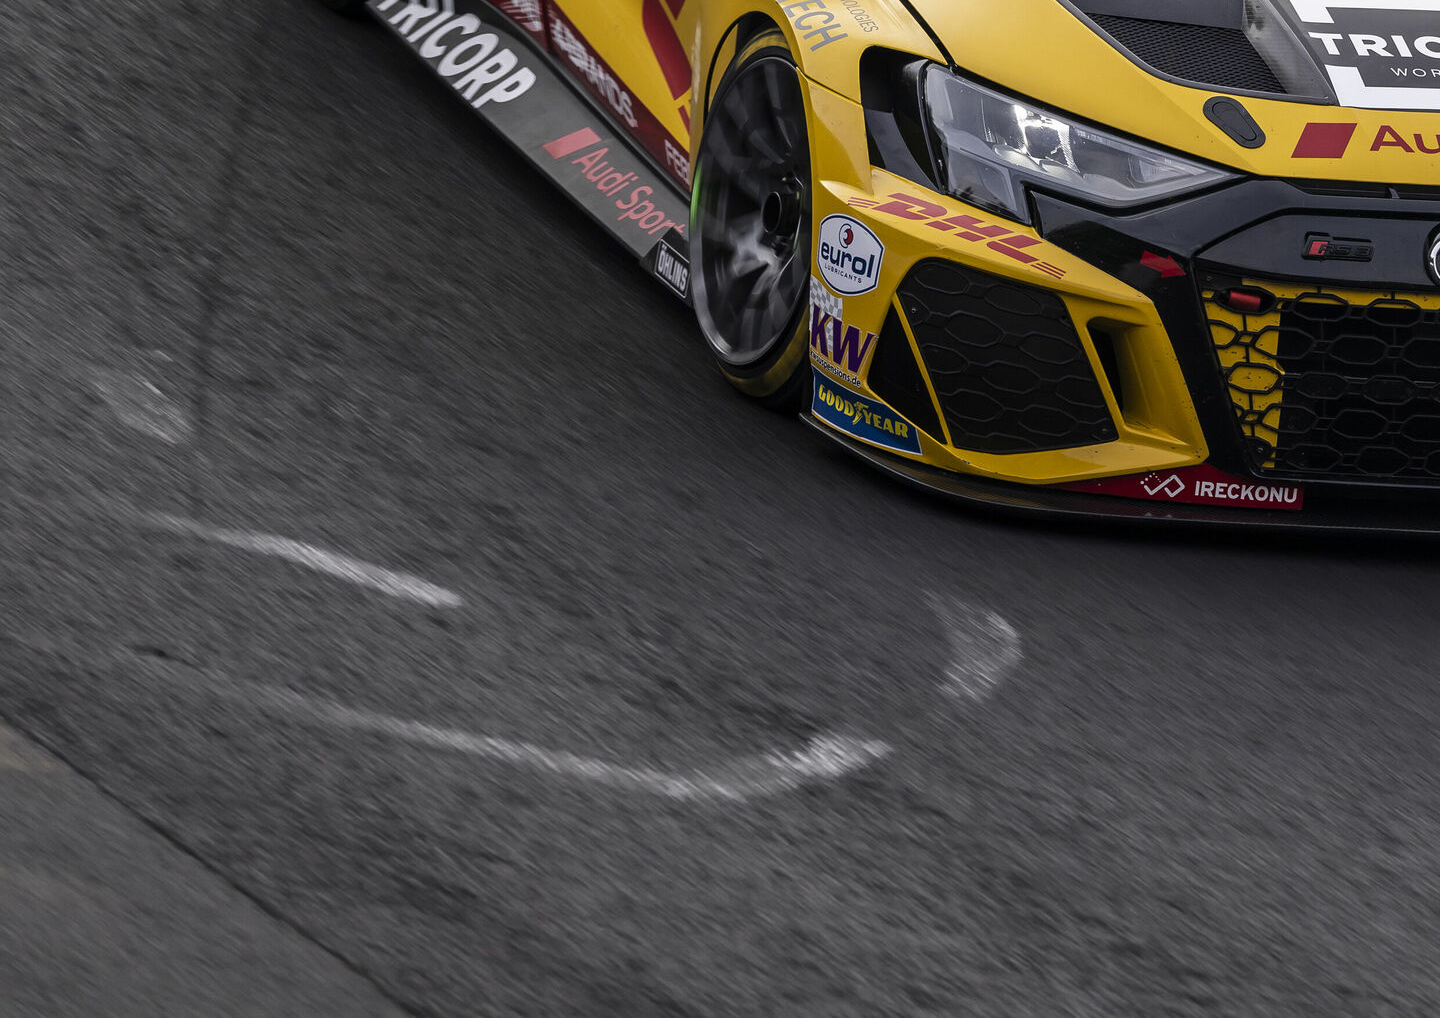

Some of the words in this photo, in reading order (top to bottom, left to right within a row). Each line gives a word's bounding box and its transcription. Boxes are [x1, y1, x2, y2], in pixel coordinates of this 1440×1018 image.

[571, 147, 639, 197] Audi
[872, 193, 1043, 264] DHL
[821, 242, 876, 279] eurol
[824, 263, 863, 284] LUBRICANTS
[810, 303, 877, 374] KW
[818, 383, 909, 439] GOODYEAR
[1194, 480, 1299, 504] IRECKONU
